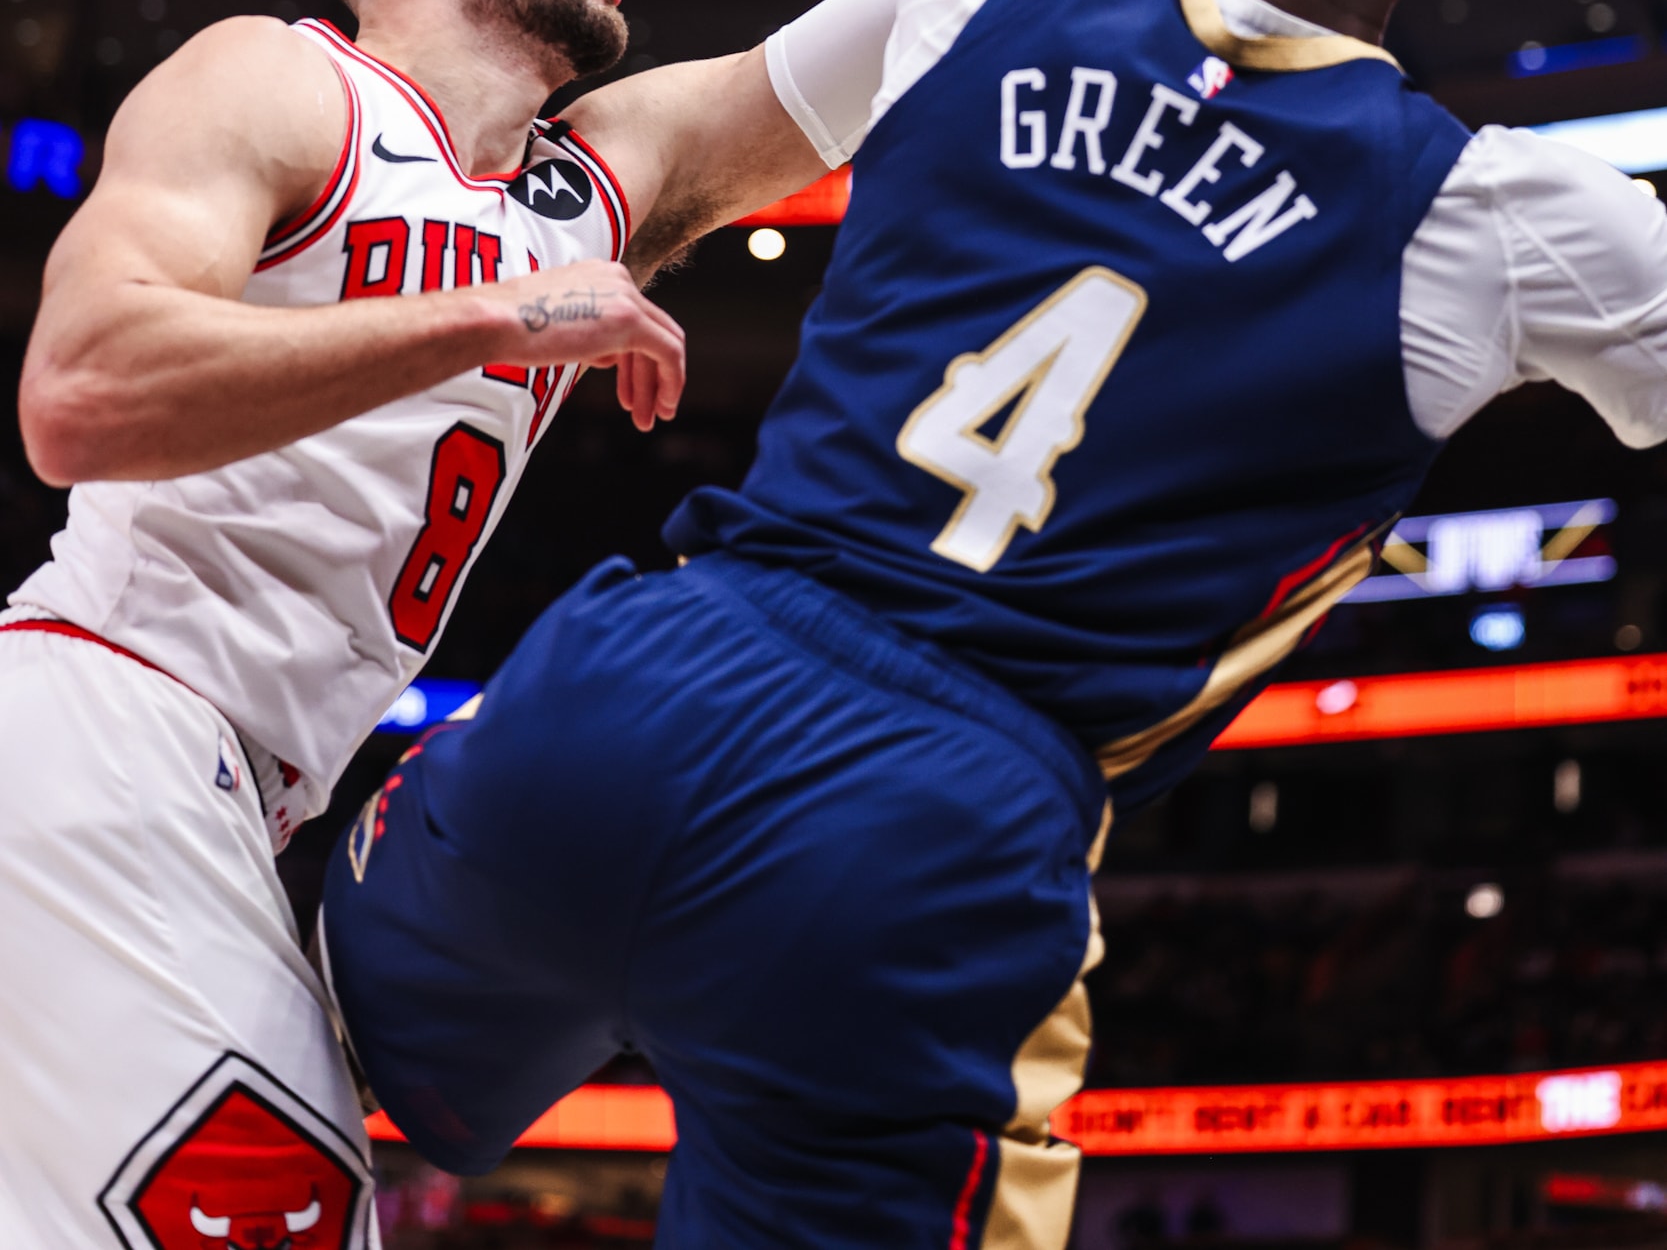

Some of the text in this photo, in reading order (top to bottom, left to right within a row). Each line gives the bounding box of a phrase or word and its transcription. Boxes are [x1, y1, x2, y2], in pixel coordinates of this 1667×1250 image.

[1000, 66, 1318, 262] GREEN
[896, 265, 1148, 573] 4
[388, 420, 506, 655] 8
